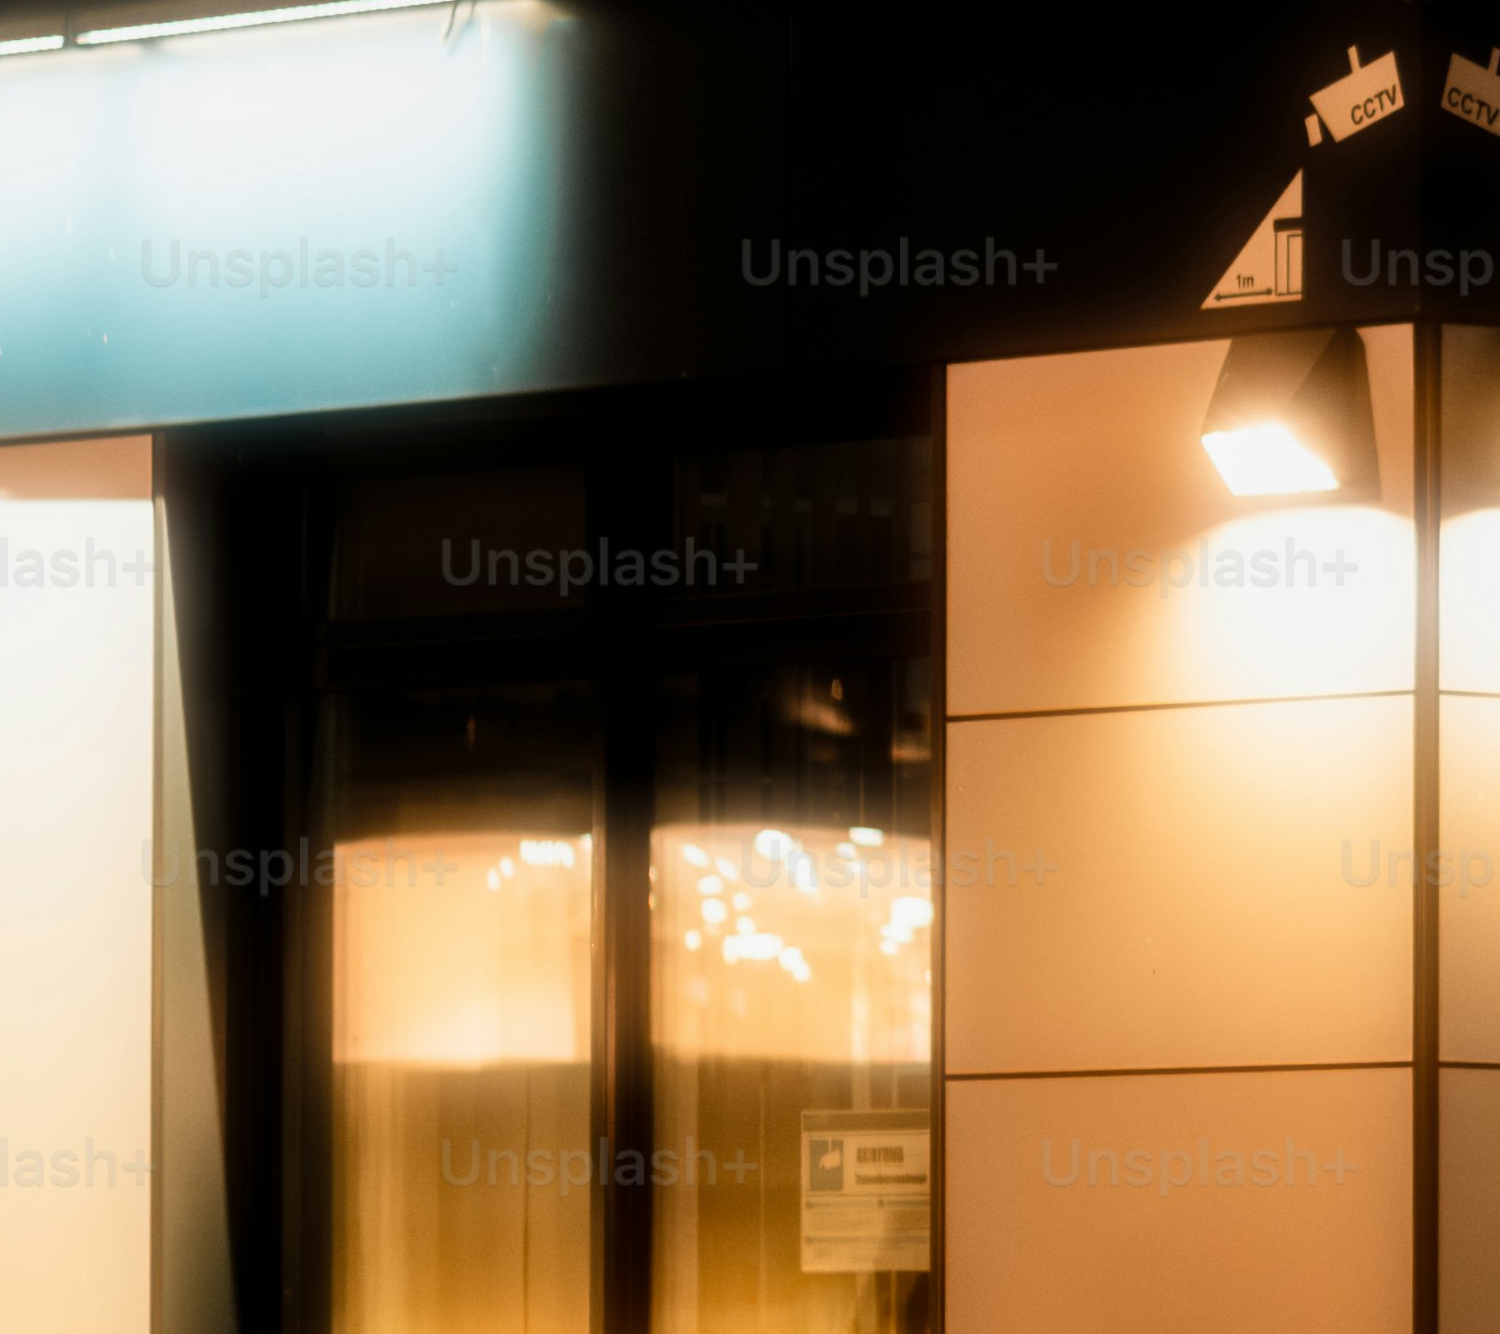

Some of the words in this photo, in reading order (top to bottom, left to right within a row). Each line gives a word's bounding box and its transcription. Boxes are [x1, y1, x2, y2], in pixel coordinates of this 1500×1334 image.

[1351, 85, 1397, 126] CCTV
[1447, 88, 1499, 126] CCTV
[1235, 273, 1255, 289] 1m
